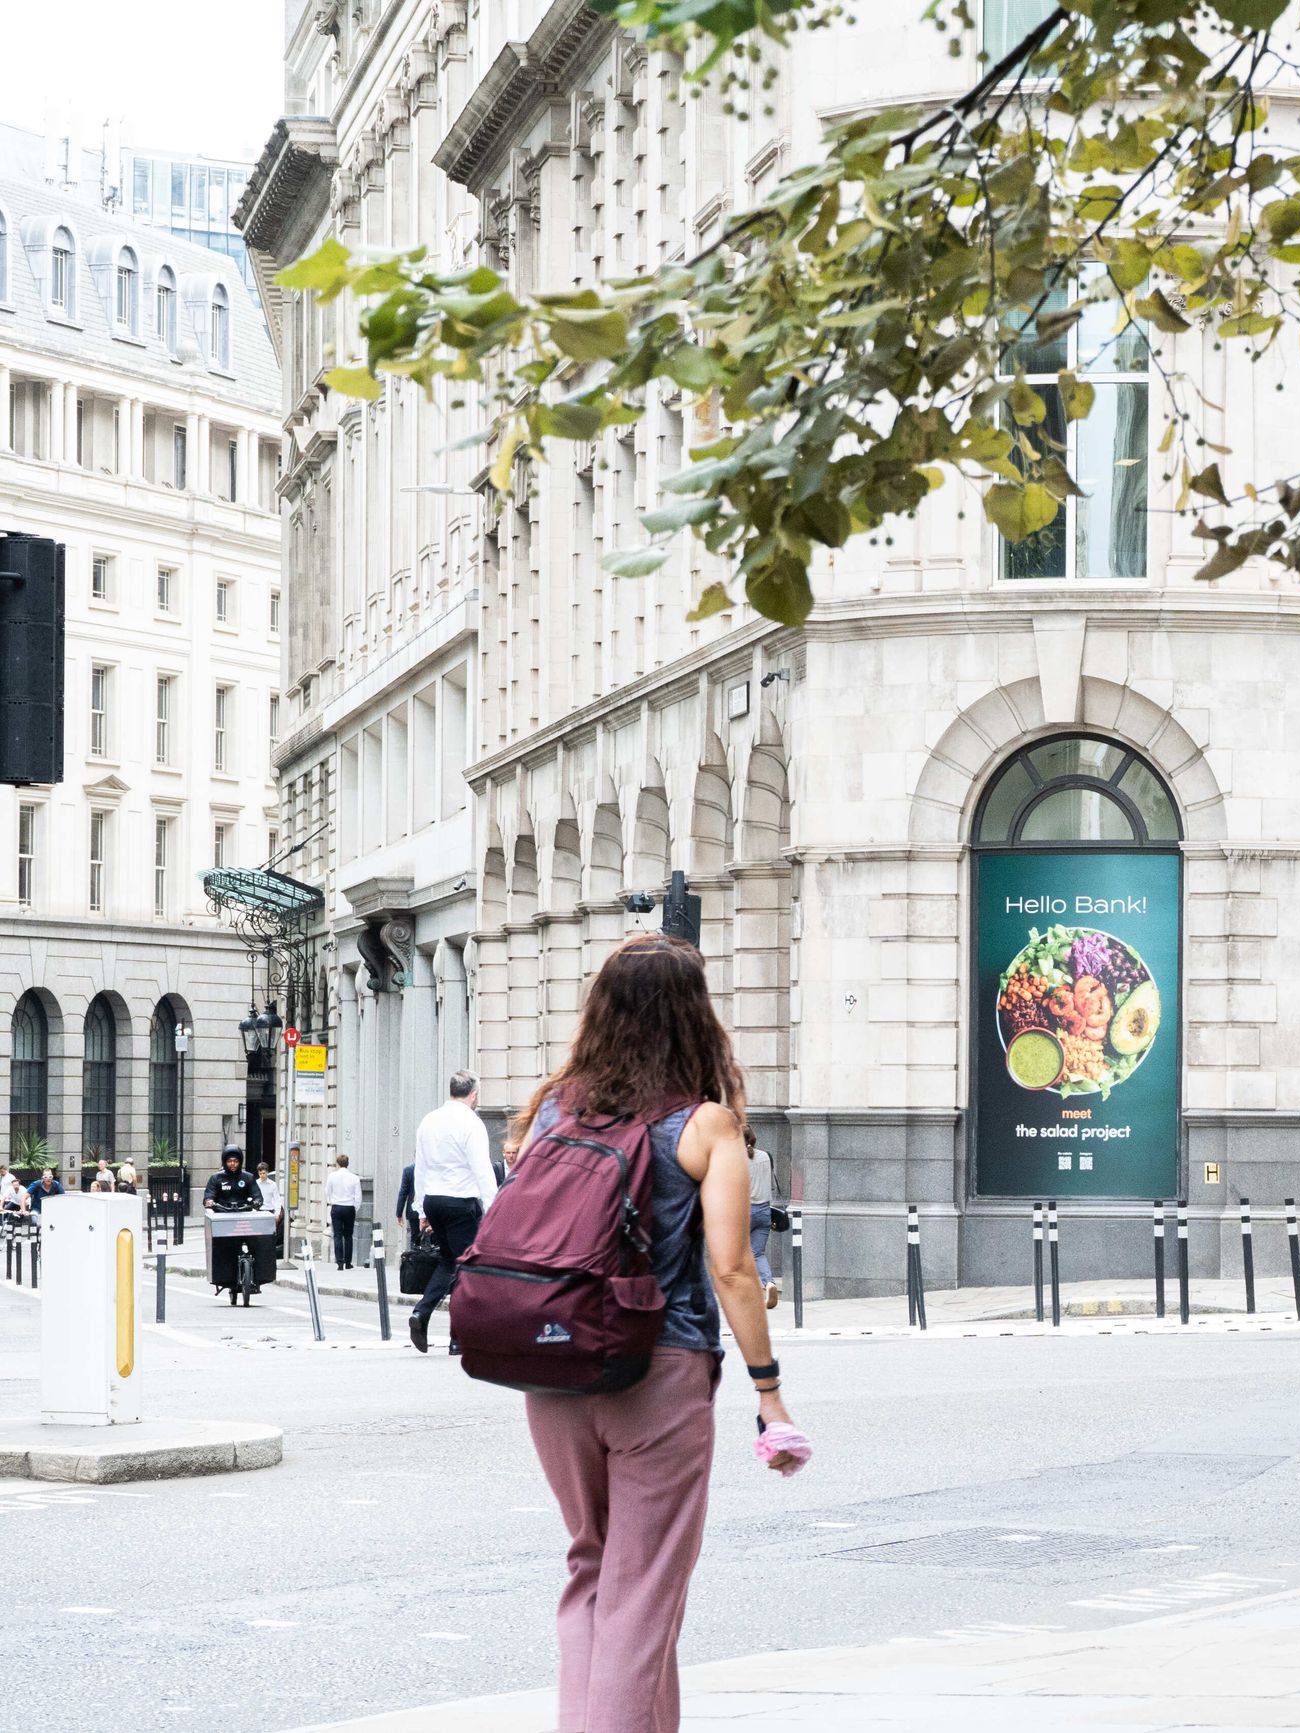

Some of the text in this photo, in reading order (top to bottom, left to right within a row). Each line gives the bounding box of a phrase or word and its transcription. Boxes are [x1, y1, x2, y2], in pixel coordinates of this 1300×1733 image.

[1006, 895, 1147, 914] Hello Bank!
[1062, 1108, 1092, 1120] meet
[1015, 1124, 1131, 1142] the salad project
